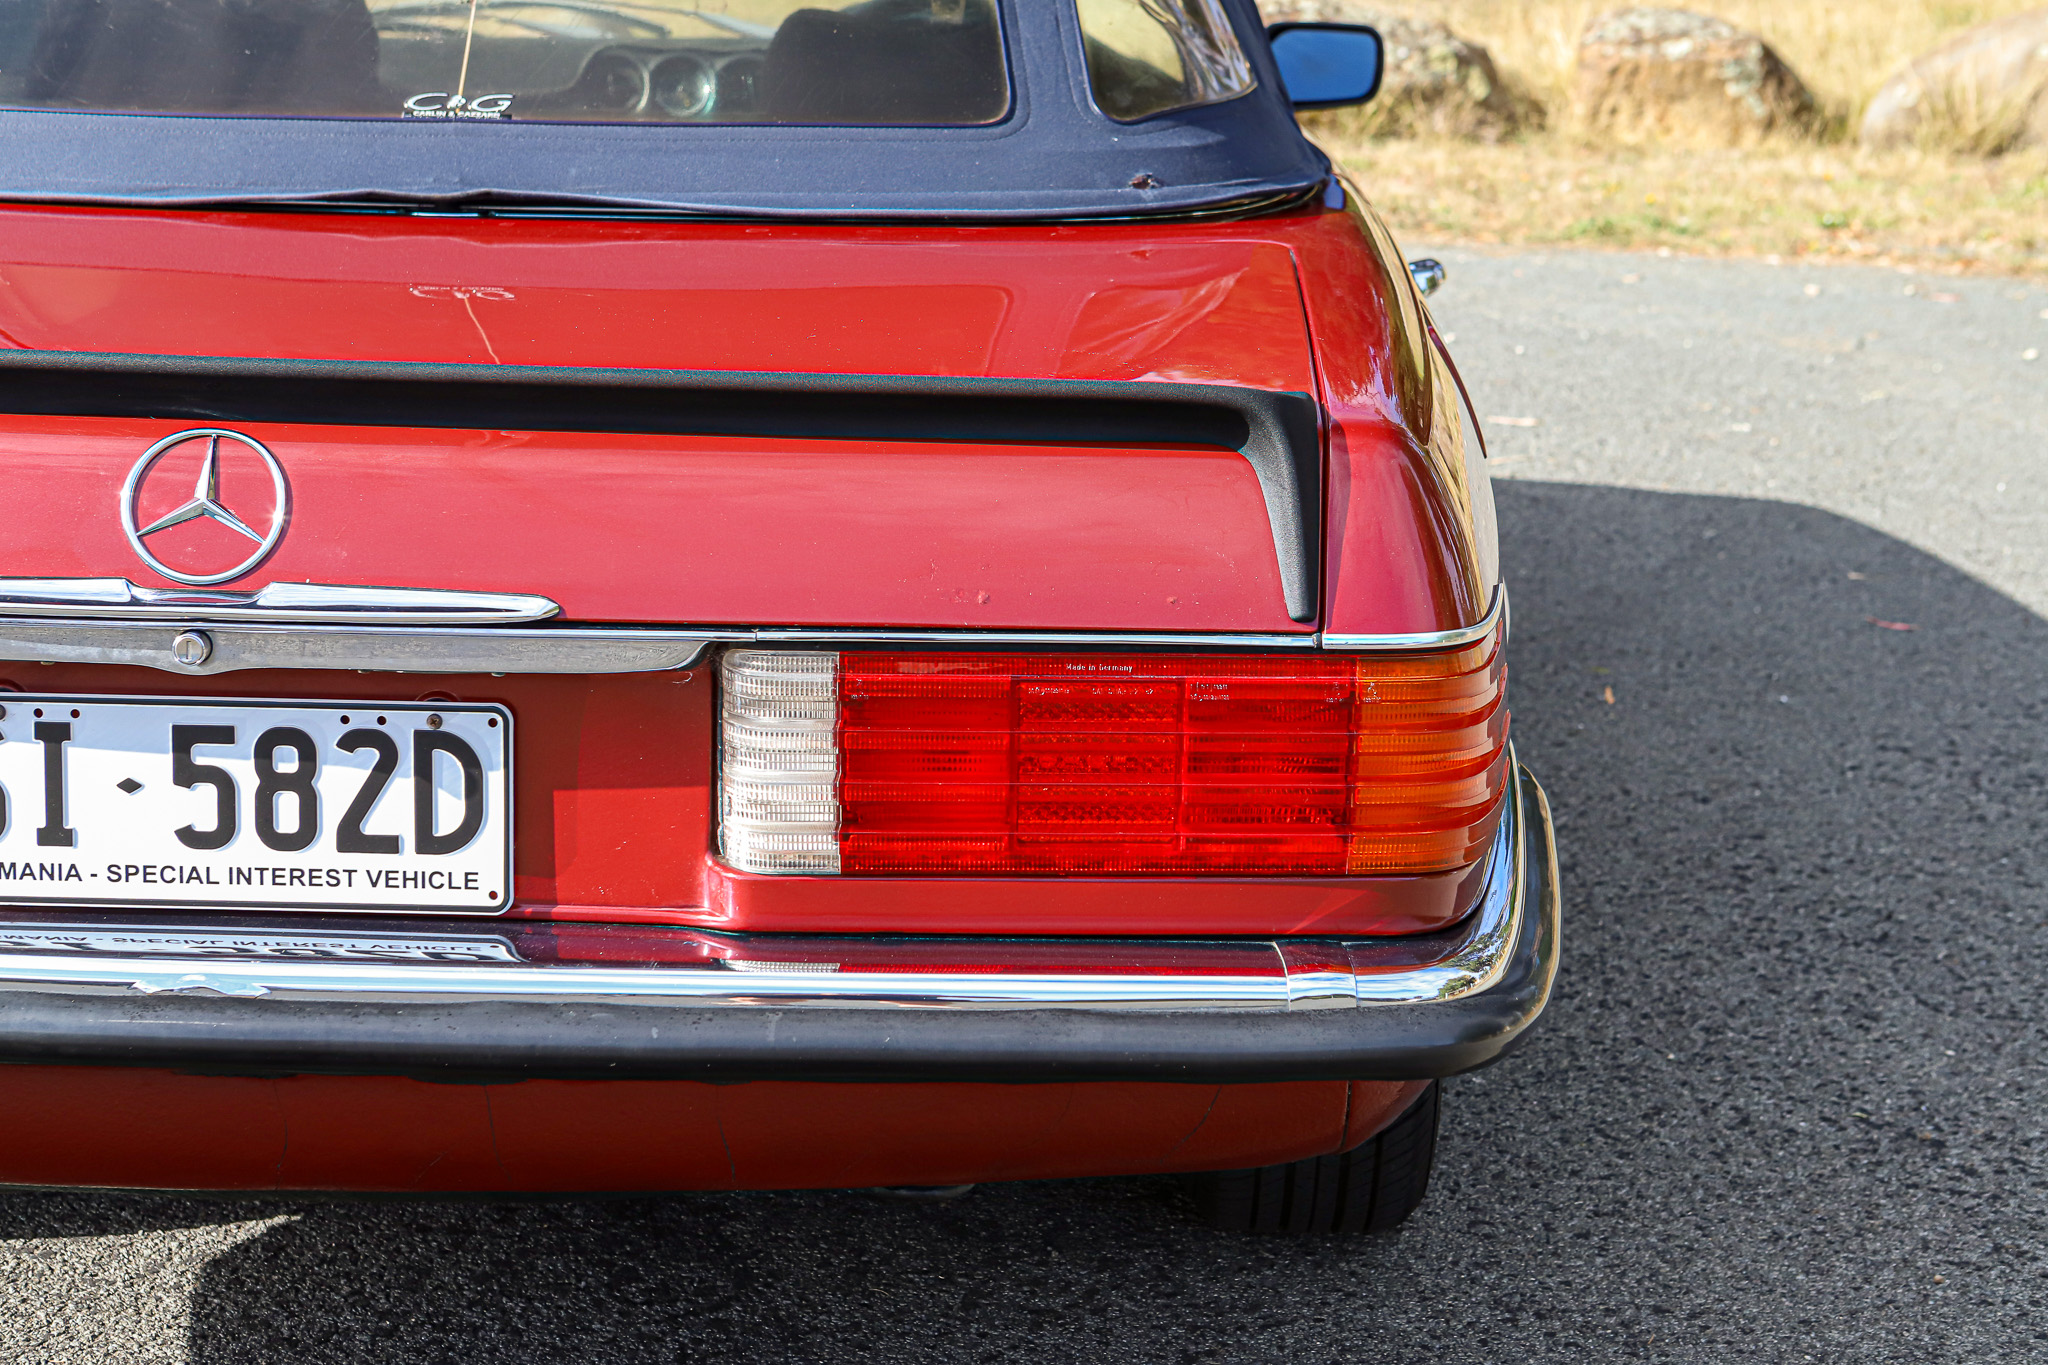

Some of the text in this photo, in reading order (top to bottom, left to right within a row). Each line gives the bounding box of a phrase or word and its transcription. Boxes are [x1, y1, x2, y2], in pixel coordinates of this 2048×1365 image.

[1066, 663, 1133, 673] Made in Germany
[0, 721, 484, 855] I 582D
[106, 864, 220, 885] SPECIAL
[228, 866, 358, 888] INTEREST
[365, 869, 479, 891] VEHICLE
